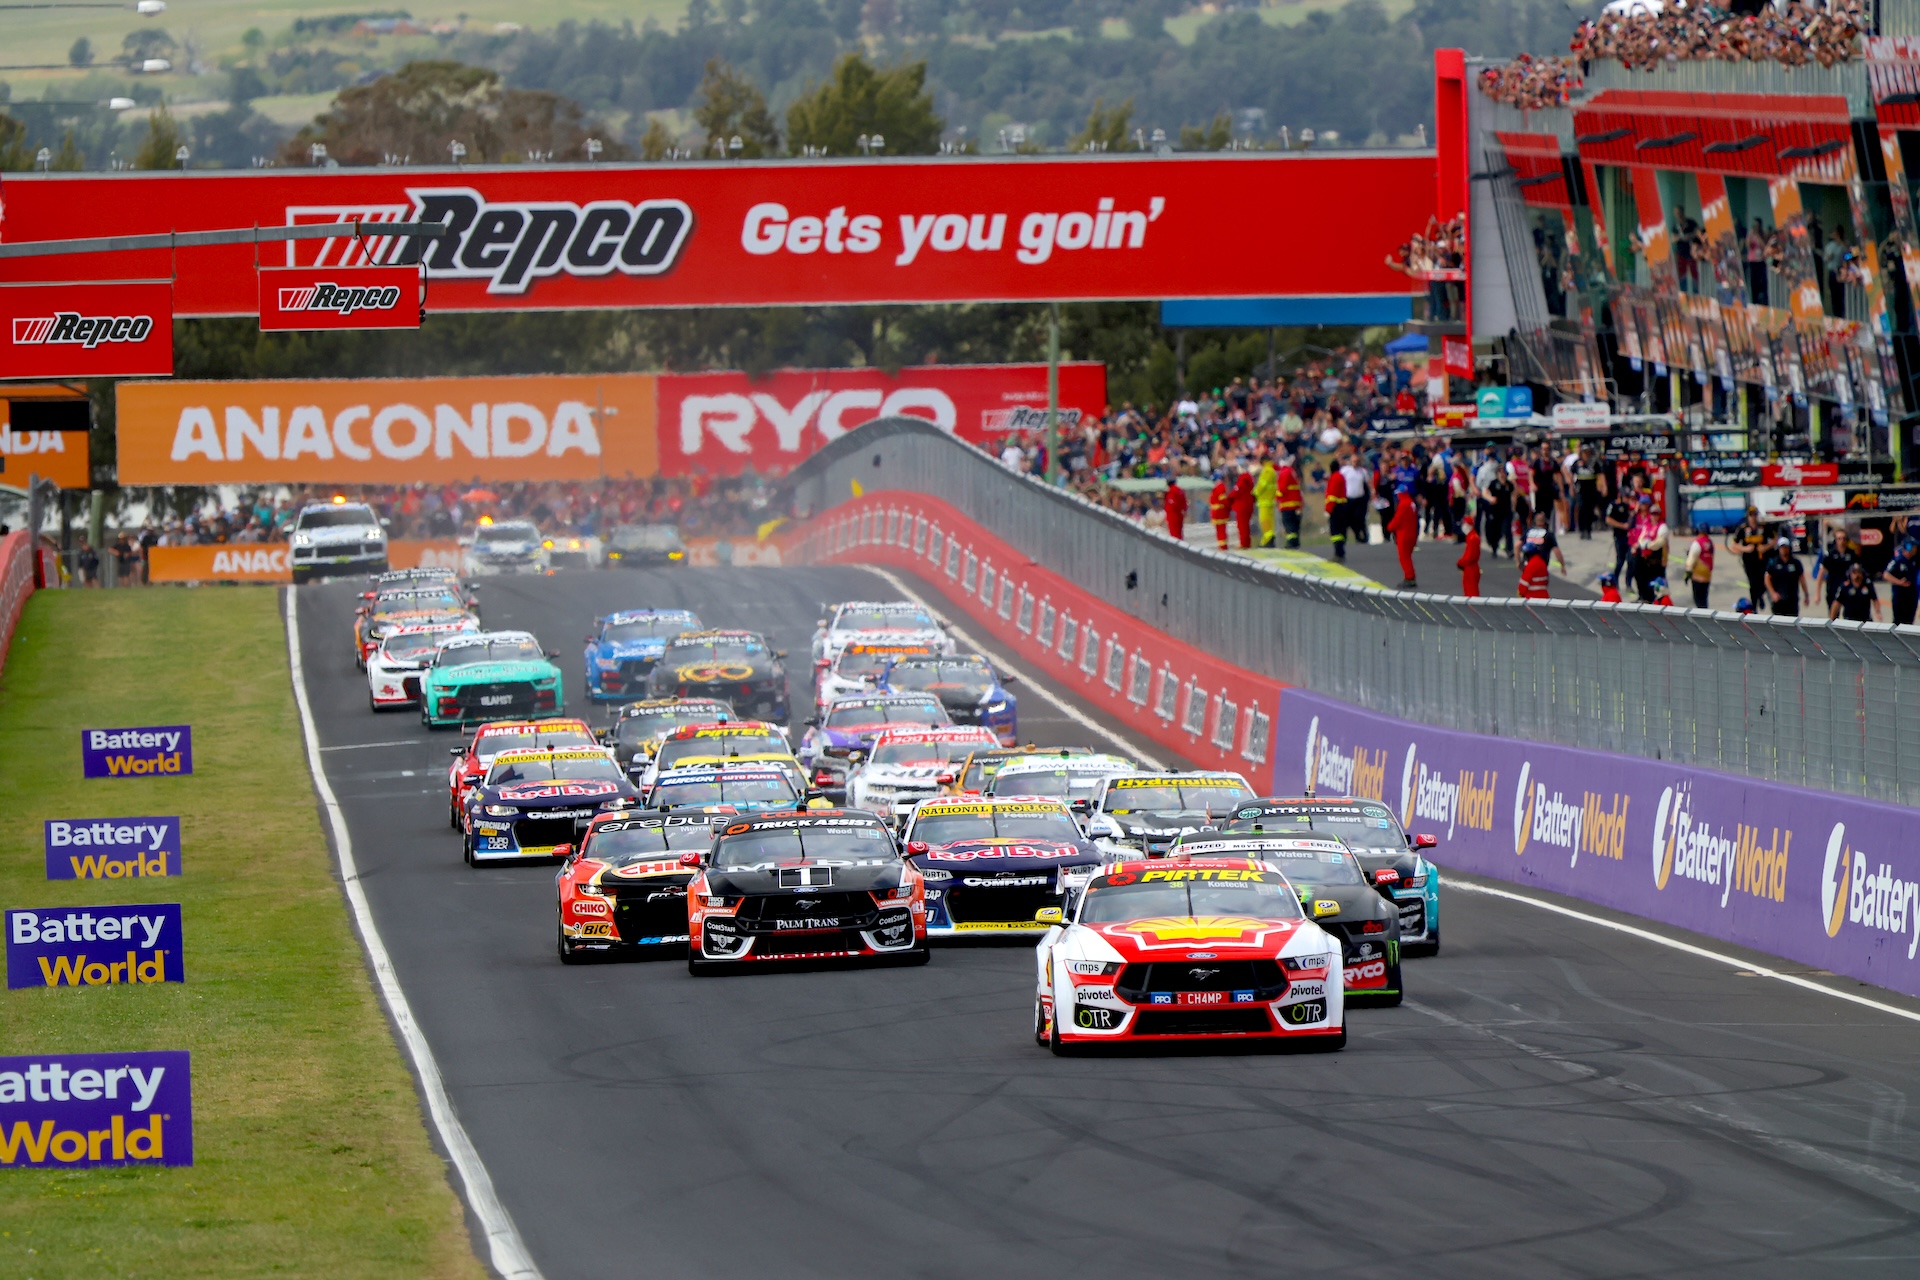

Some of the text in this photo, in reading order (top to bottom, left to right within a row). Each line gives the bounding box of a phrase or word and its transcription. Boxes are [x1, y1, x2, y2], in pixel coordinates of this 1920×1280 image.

[400, 187, 693, 293] Repco
[741, 202, 882, 255] Gets
[895, 212, 1006, 266] you
[310, 282, 400, 315] Repco
[46, 311, 153, 349] Repco
[680, 386, 956, 456] RYCO
[171, 401, 601, 462] ANACONDA
[484, 724, 583, 737] MAKE IT SUPER
[696, 728, 769, 737] PIRTEK
[90, 730, 181, 753] Battery
[105, 752, 180, 775] World
[496, 752, 608, 764] NATIONAL STORAGE
[1028, 762, 1131, 771] FAW TRUCKS
[1318, 735, 1387, 800] Battery World
[662, 776, 715, 785] BURSON
[1117, 777, 1242, 787] Hydraulink
[500, 784, 618, 800] Red Bull
[921, 804, 1062, 816] NATIONAL STORAGE
[1416, 762, 1496, 841] Battery World
[599, 815, 731, 833] erebus
[752, 820, 812, 830] TRUCK
[1533, 782, 1628, 868] Battery World
[50, 821, 168, 850] Battery
[928, 844, 1080, 861] Red Bull
[1675, 811, 1791, 908] Battery World
[70, 850, 168, 879] World
[962, 876, 1048, 887] COMPLETE
[1141, 870, 1267, 883] PIRTEK
[1208, 881, 1248, 889] Kostecki
[574, 903, 606, 913] CHIKO
[1850, 850, 1920, 960] Battery
[12, 912, 166, 949] Battery
[584, 924, 609, 934] BIC
[776, 917, 839, 930] PALM TRANS
[1362, 920, 1383, 932] dba
[38, 950, 166, 986] World
[1079, 962, 1100, 974] mps
[1308, 956, 1326, 968] mps
[1344, 962, 1385, 982] RYCO
[1078, 988, 1114, 1002] pivotel.
[1188, 992, 1222, 1004] CH4MP
[1237, 994, 1254, 1002] PPQ
[1291, 984, 1324, 998] pivotel.
[1154, 996, 1172, 1004] PPQ
[1079, 1010, 1112, 1028] OTR
[1292, 1004, 1322, 1022] OTR
[0, 1063, 165, 1112] attery
[0, 1114, 163, 1163] World
